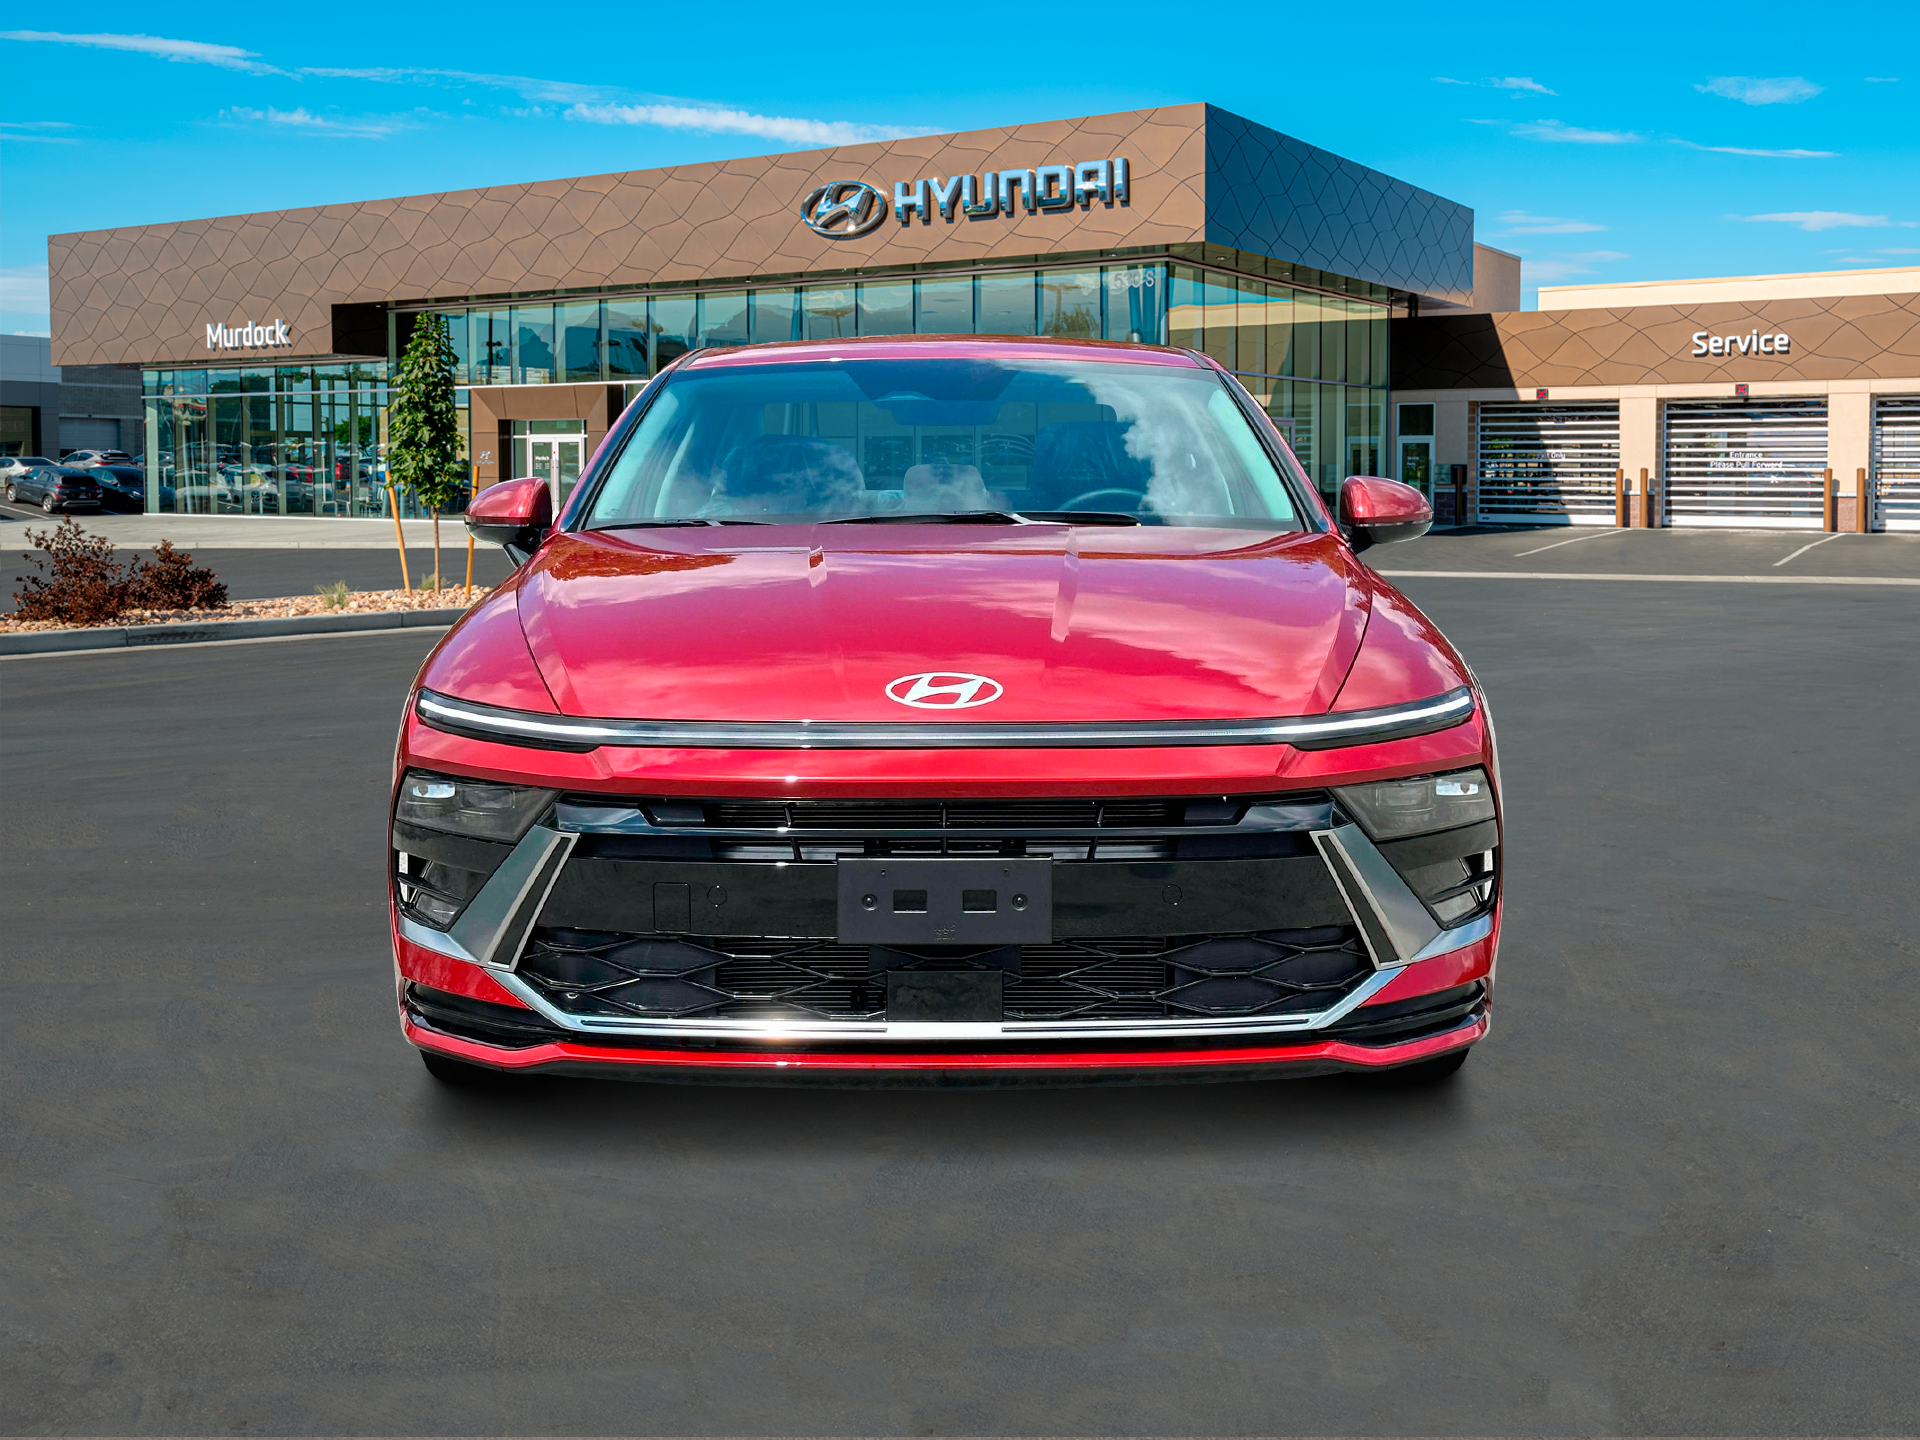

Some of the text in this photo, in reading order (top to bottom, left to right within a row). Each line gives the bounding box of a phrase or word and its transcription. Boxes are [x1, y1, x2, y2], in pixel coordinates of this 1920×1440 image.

[895, 157, 1130, 224] HYUNDAI
[1114, 270, 1155, 290] 530 S
[206, 318, 292, 349] Murdock
[1691, 329, 1790, 356] Service
[1710, 461, 1735, 469] Please
[1736, 461, 1750, 469] Pull
[1729, 451, 1763, 459] Entrance
